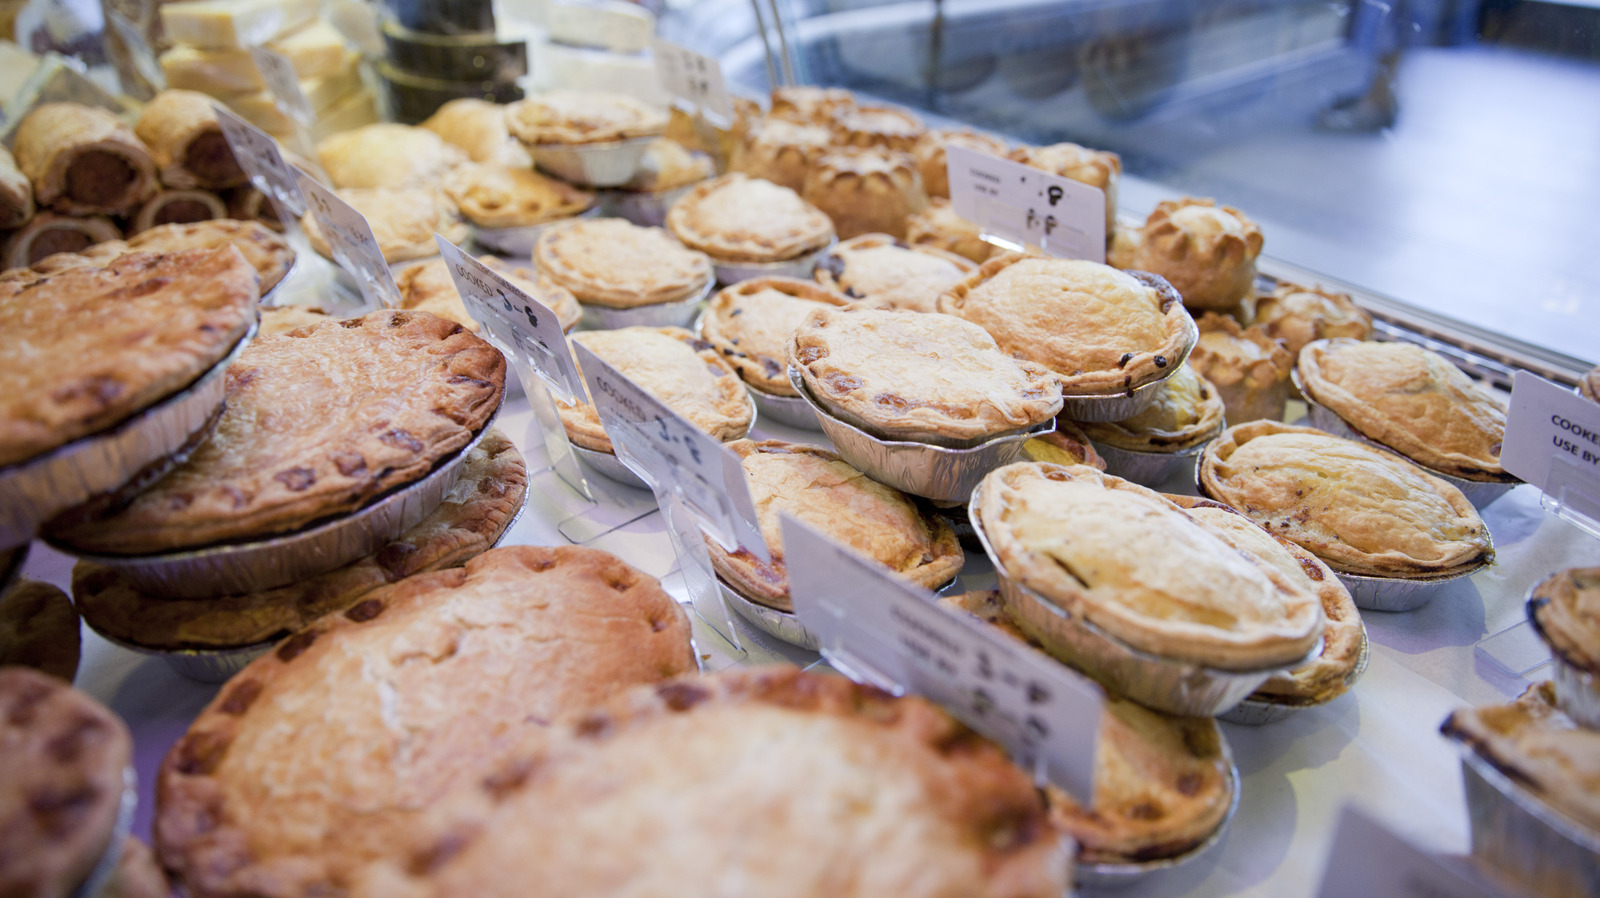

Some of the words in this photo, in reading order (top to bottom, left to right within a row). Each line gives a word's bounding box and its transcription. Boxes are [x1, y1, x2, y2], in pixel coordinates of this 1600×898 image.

[455, 263, 493, 297] COOKED
[1551, 414, 1600, 447] COOKE
[1553, 435, 1579, 456] USE
[1582, 450, 1600, 466] BY
